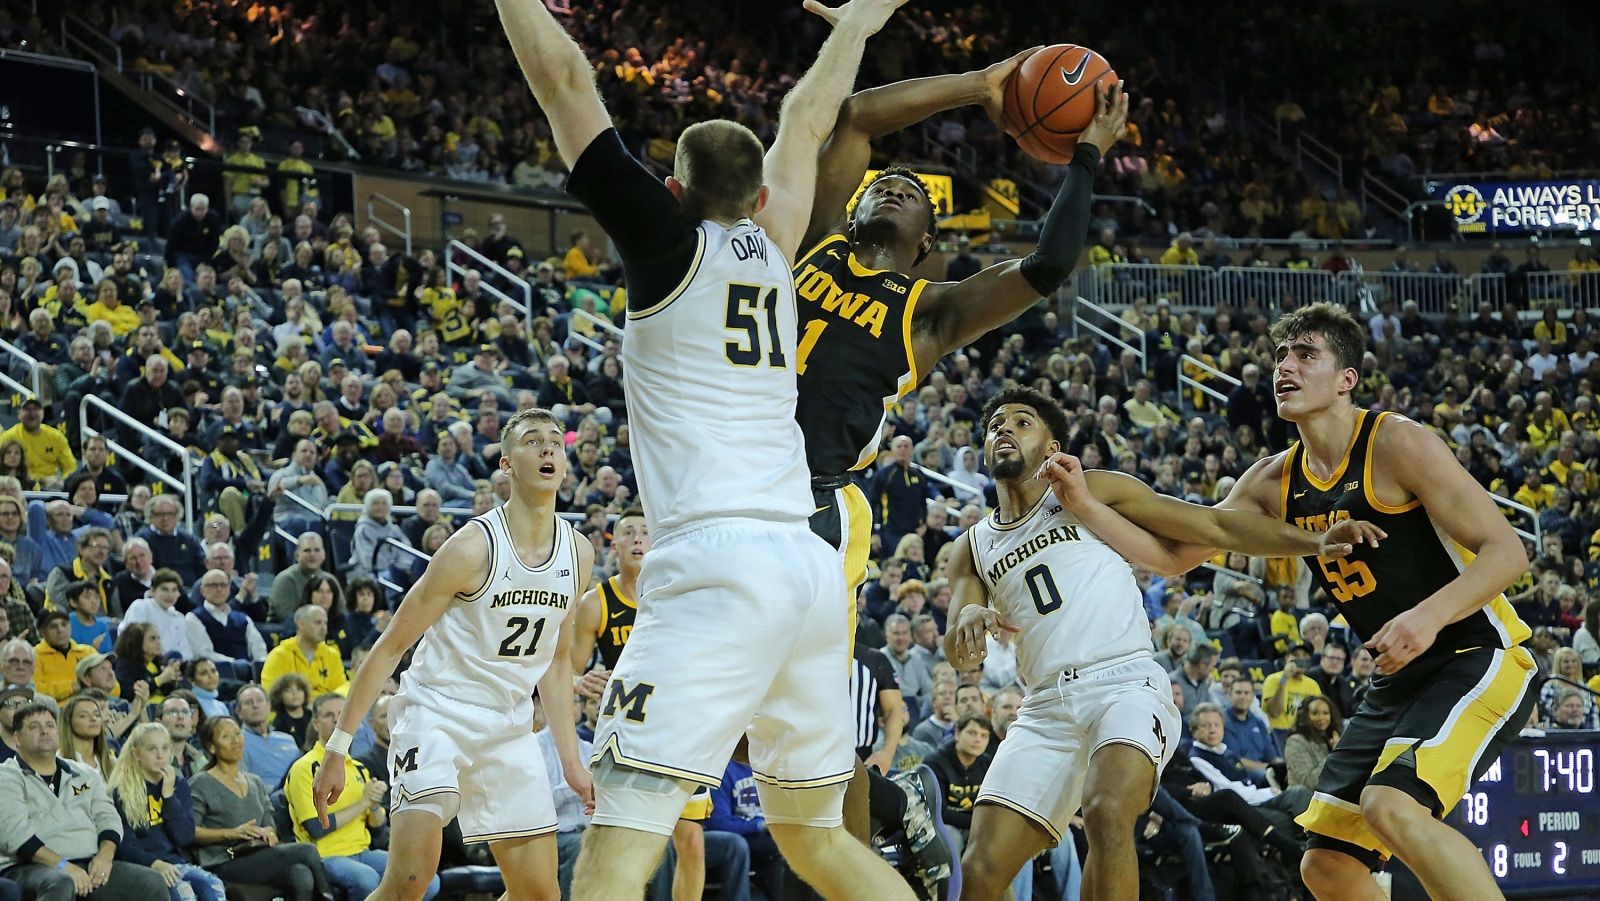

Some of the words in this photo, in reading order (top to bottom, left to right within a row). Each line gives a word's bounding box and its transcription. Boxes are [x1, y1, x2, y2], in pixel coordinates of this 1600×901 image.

[1492, 185, 1582, 206] ALWAYS
[1587, 184, 1600, 204] L
[1492, 204, 1592, 228] FOREVER
[795, 263, 889, 338] IOWA
[725, 282, 787, 369] 51
[987, 525, 1081, 587] MICHIGAN
[1024, 563, 1063, 616] 0
[1317, 555, 1377, 603] 55
[490, 589, 569, 610] MICHIGAN
[497, 616, 546, 658] 21
[603, 678, 656, 723] M
[393, 746, 420, 780] M
[1533, 749, 1594, 793] 7:40
[1538, 811, 1580, 832] PERIOD
[1494, 843, 1508, 878] 8
[1513, 852, 1542, 868] FOULS
[1553, 841, 1567, 875] 2
[1581, 849, 1600, 865] FOU
